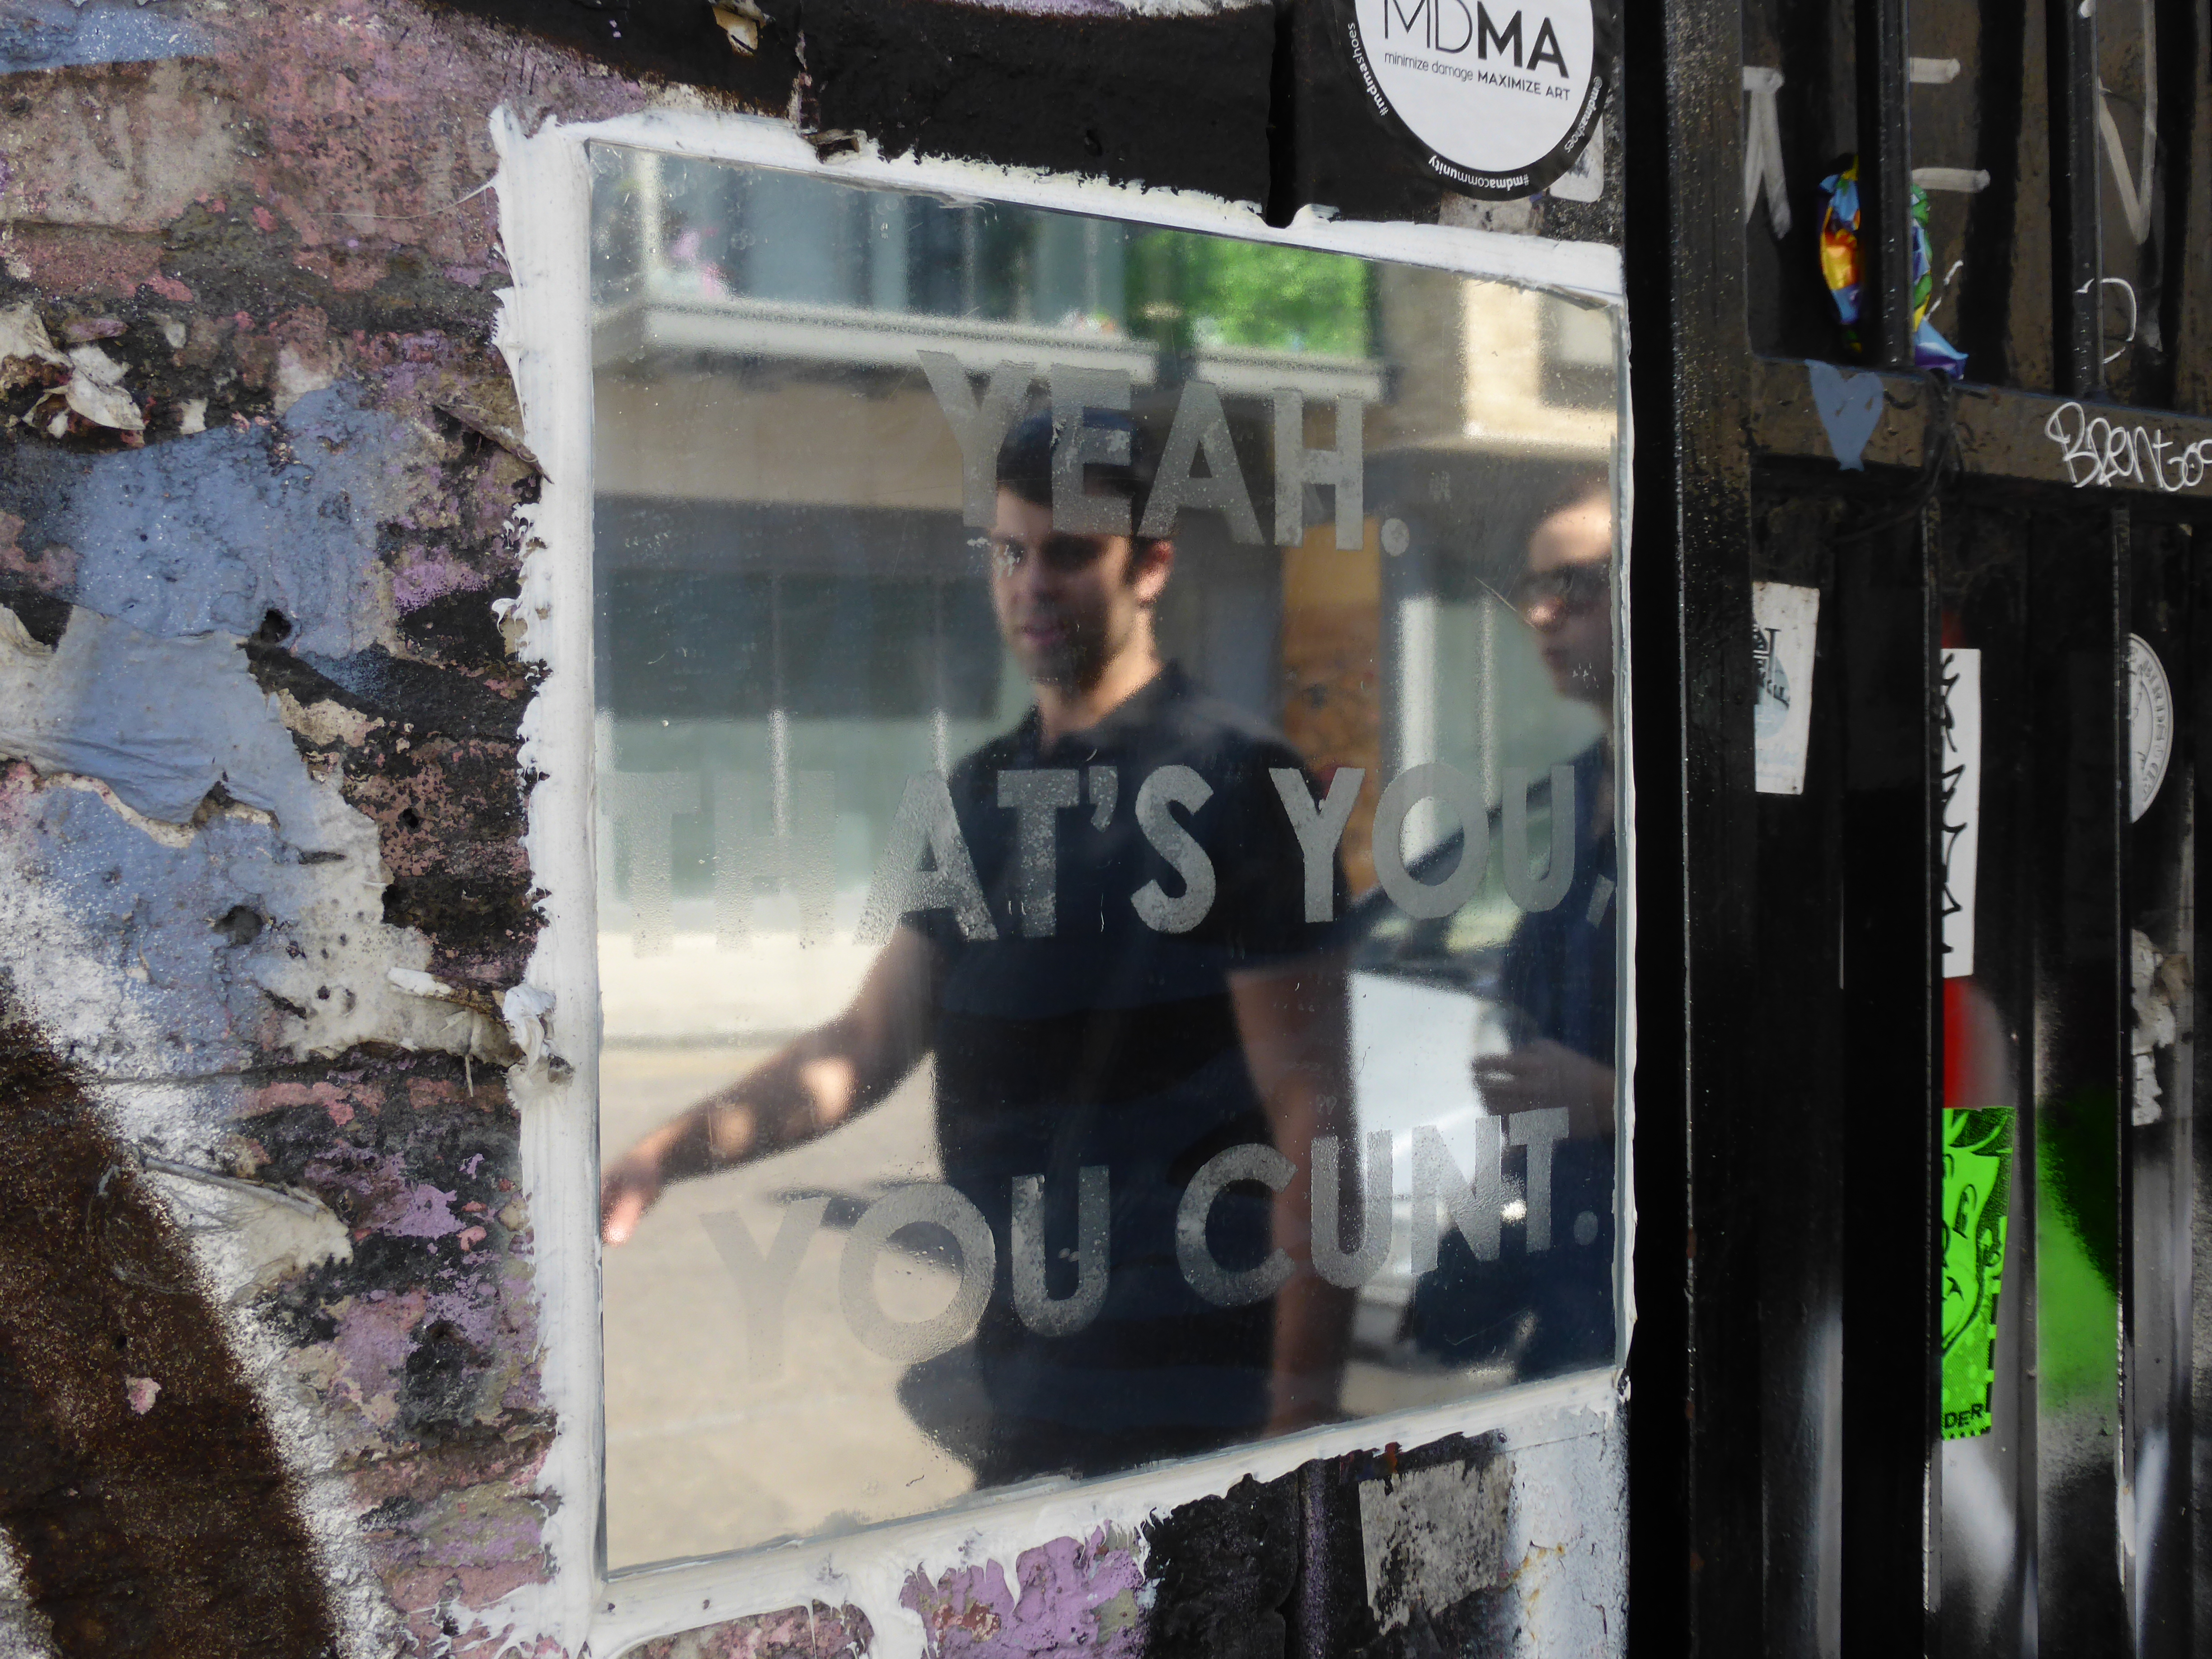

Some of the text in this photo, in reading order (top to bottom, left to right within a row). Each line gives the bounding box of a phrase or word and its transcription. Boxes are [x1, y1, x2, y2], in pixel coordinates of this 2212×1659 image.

[1348, 22, 1389, 117] #mdmashoes
[1384, 0, 1570, 78] MDMA
[1384, 52, 1571, 101] minimize damage MAXIMIZE ART
[1564, 75, 1603, 153] @mdmashoes
[1428, 155, 1529, 191] #mdmacommunity
[917, 350, 1410, 556] YEAH.
[1269, 763, 1614, 928] YOU,
[699, 1107, 1598, 1384] YOU CUNT.
